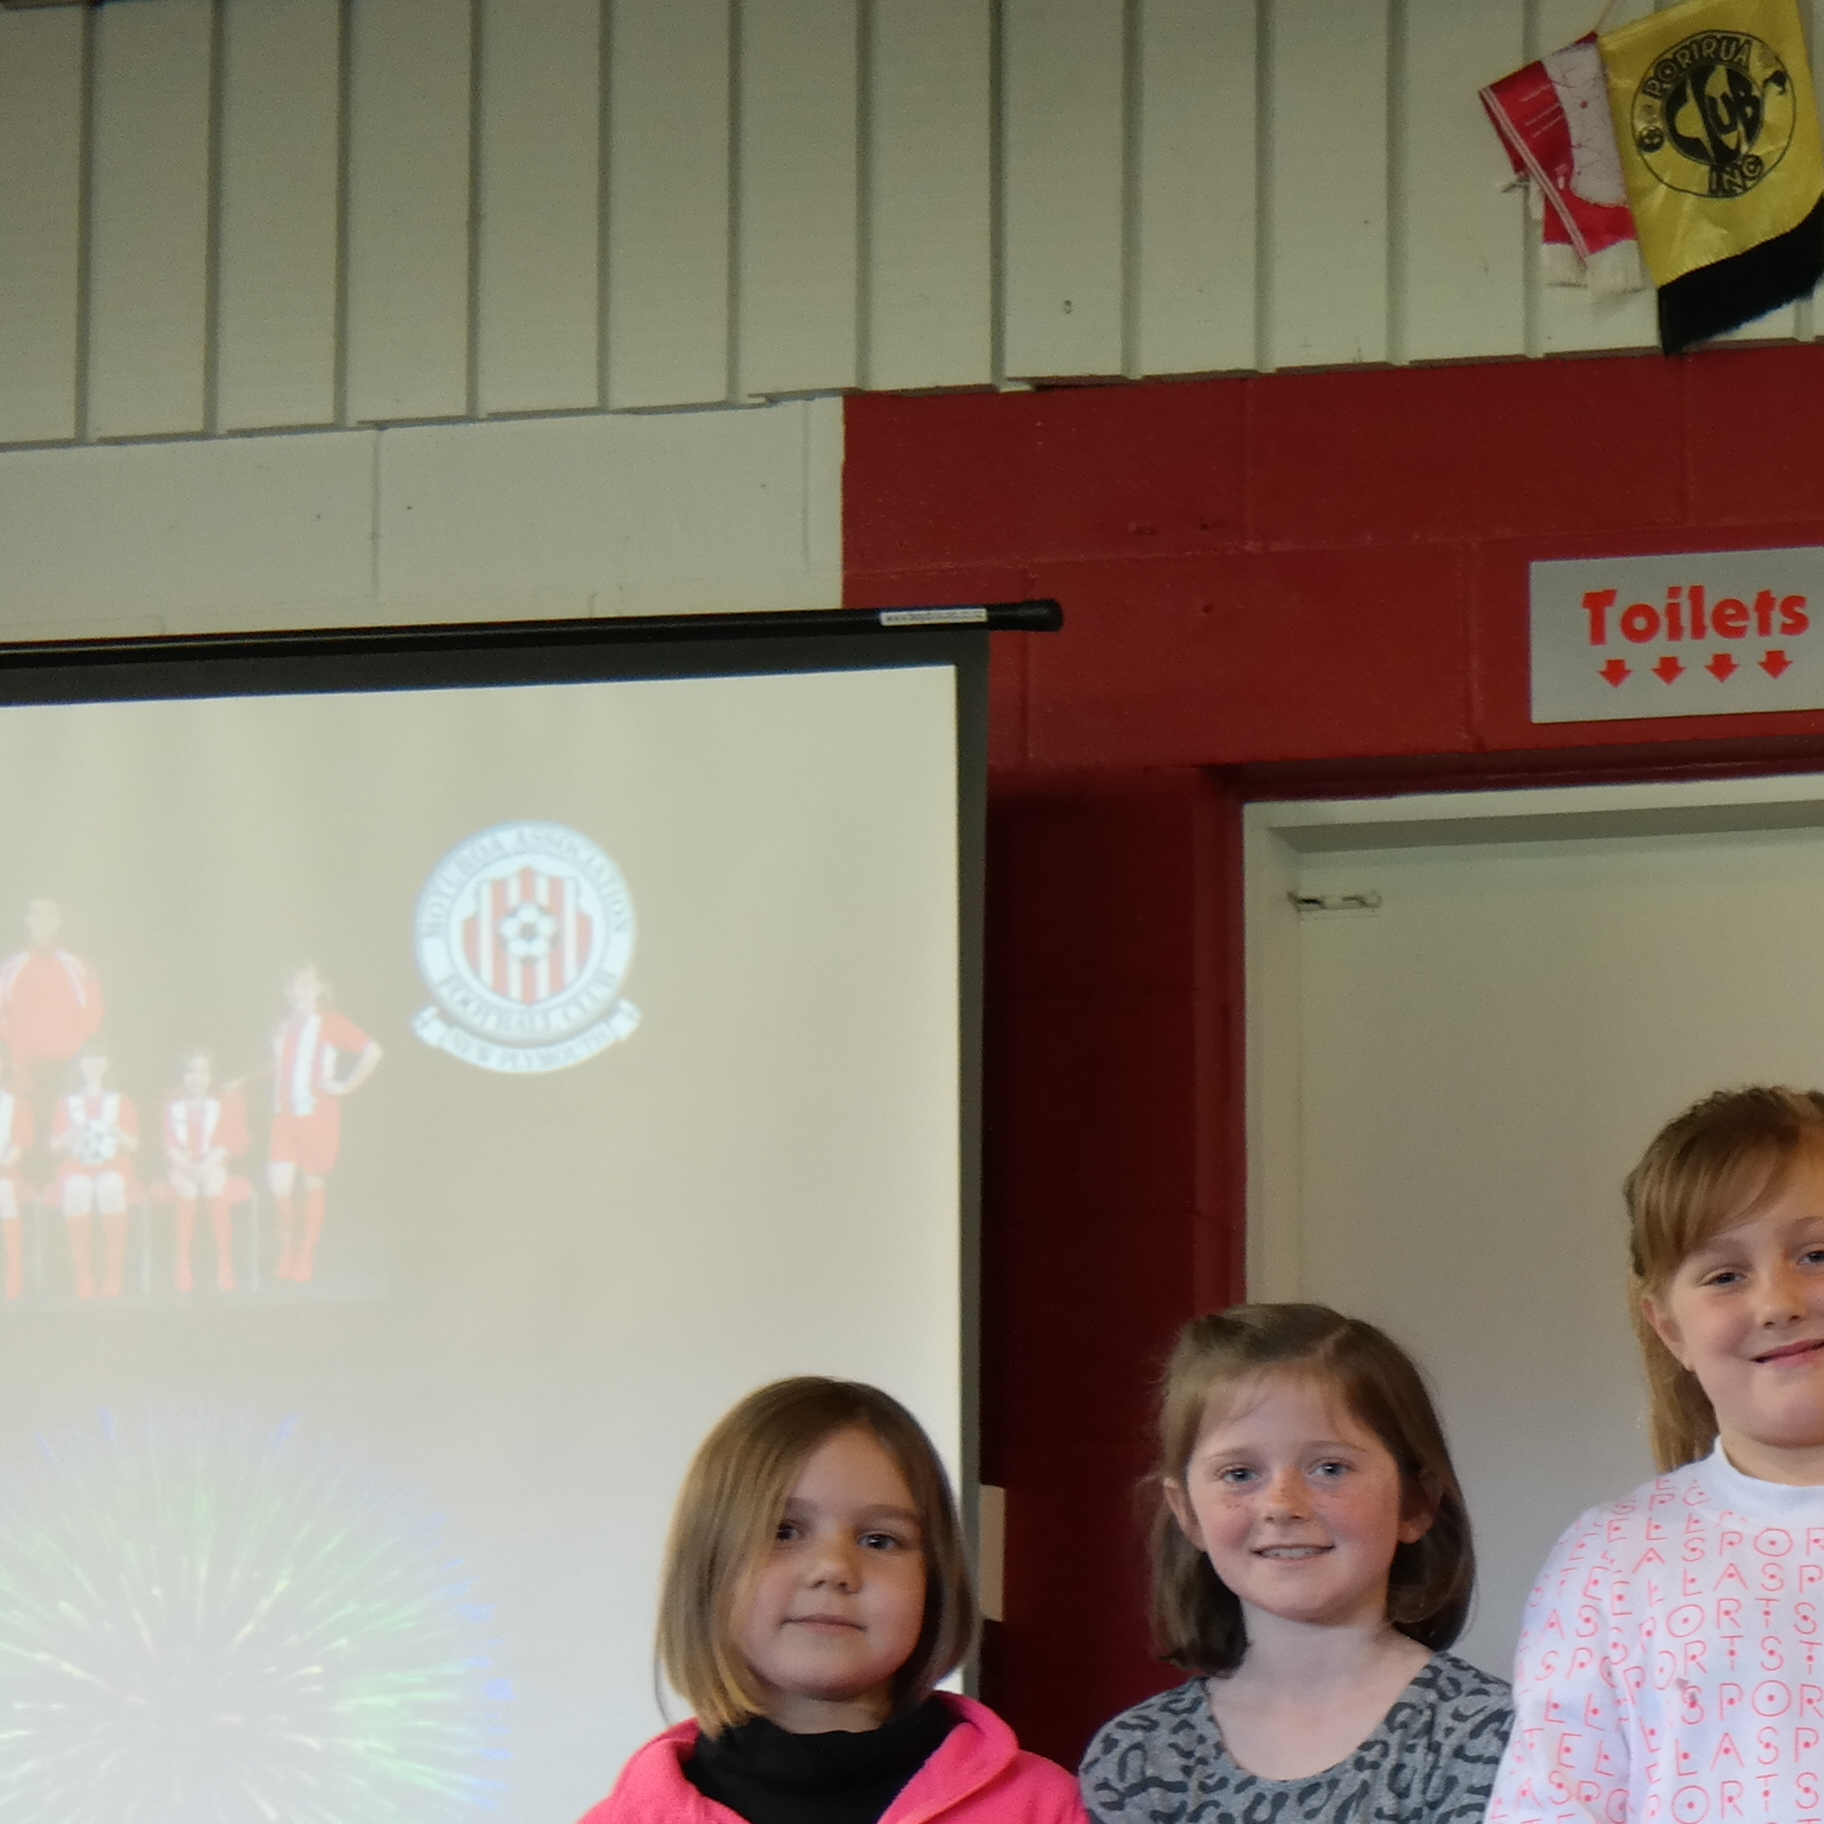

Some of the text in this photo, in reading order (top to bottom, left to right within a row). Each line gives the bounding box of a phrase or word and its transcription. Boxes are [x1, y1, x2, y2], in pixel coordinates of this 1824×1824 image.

[1642, 34, 1753, 100] PORIRUA
[1709, 153, 1764, 195] INC
[1582, 584, 1811, 646] Toilets
